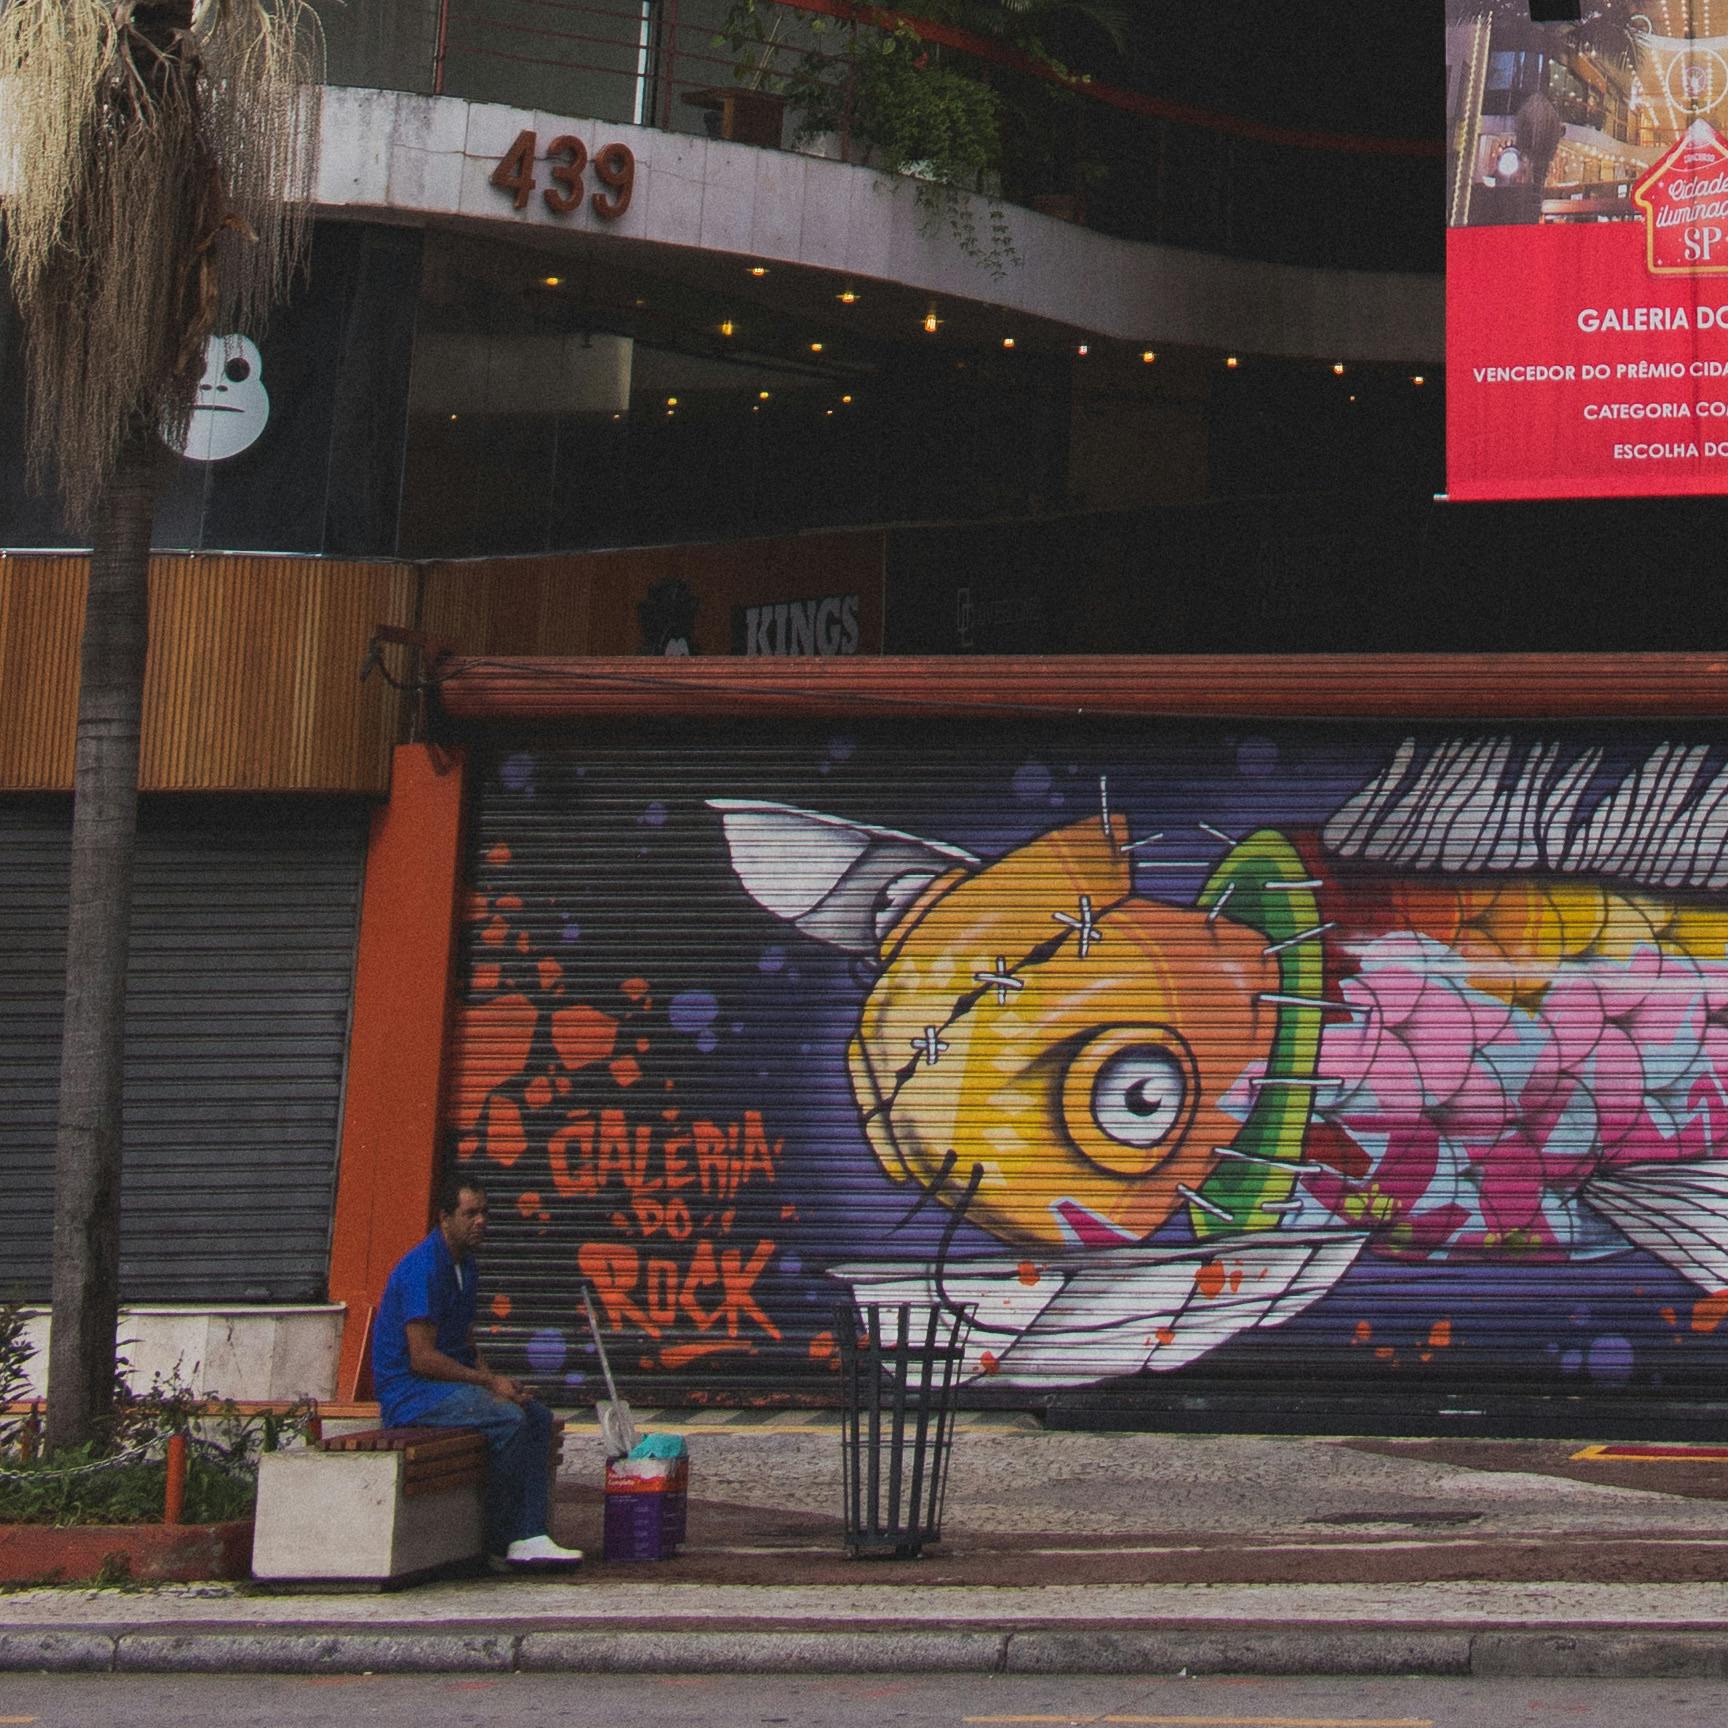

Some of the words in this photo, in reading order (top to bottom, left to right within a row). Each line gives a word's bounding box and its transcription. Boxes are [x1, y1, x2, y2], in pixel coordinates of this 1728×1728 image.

[488, 129, 637, 221] 439
[1684, 226, 1723, 261] SP
[1577, 307, 1688, 333] GALERIA
[1473, 364, 1576, 384] VENCEDOR
[1581, 363, 1612, 381] DO
[1616, 358, 1686, 380] PRÊMIO
[1583, 401, 1691, 421] CATEGORIA
[1613, 442, 1699, 460] ESCOLHA
[745, 594, 860, 657] KINGS
[547, 1108, 777, 1200] GALERIA
[633, 1196, 694, 1241] DO
[577, 1238, 784, 1342] ROCK
